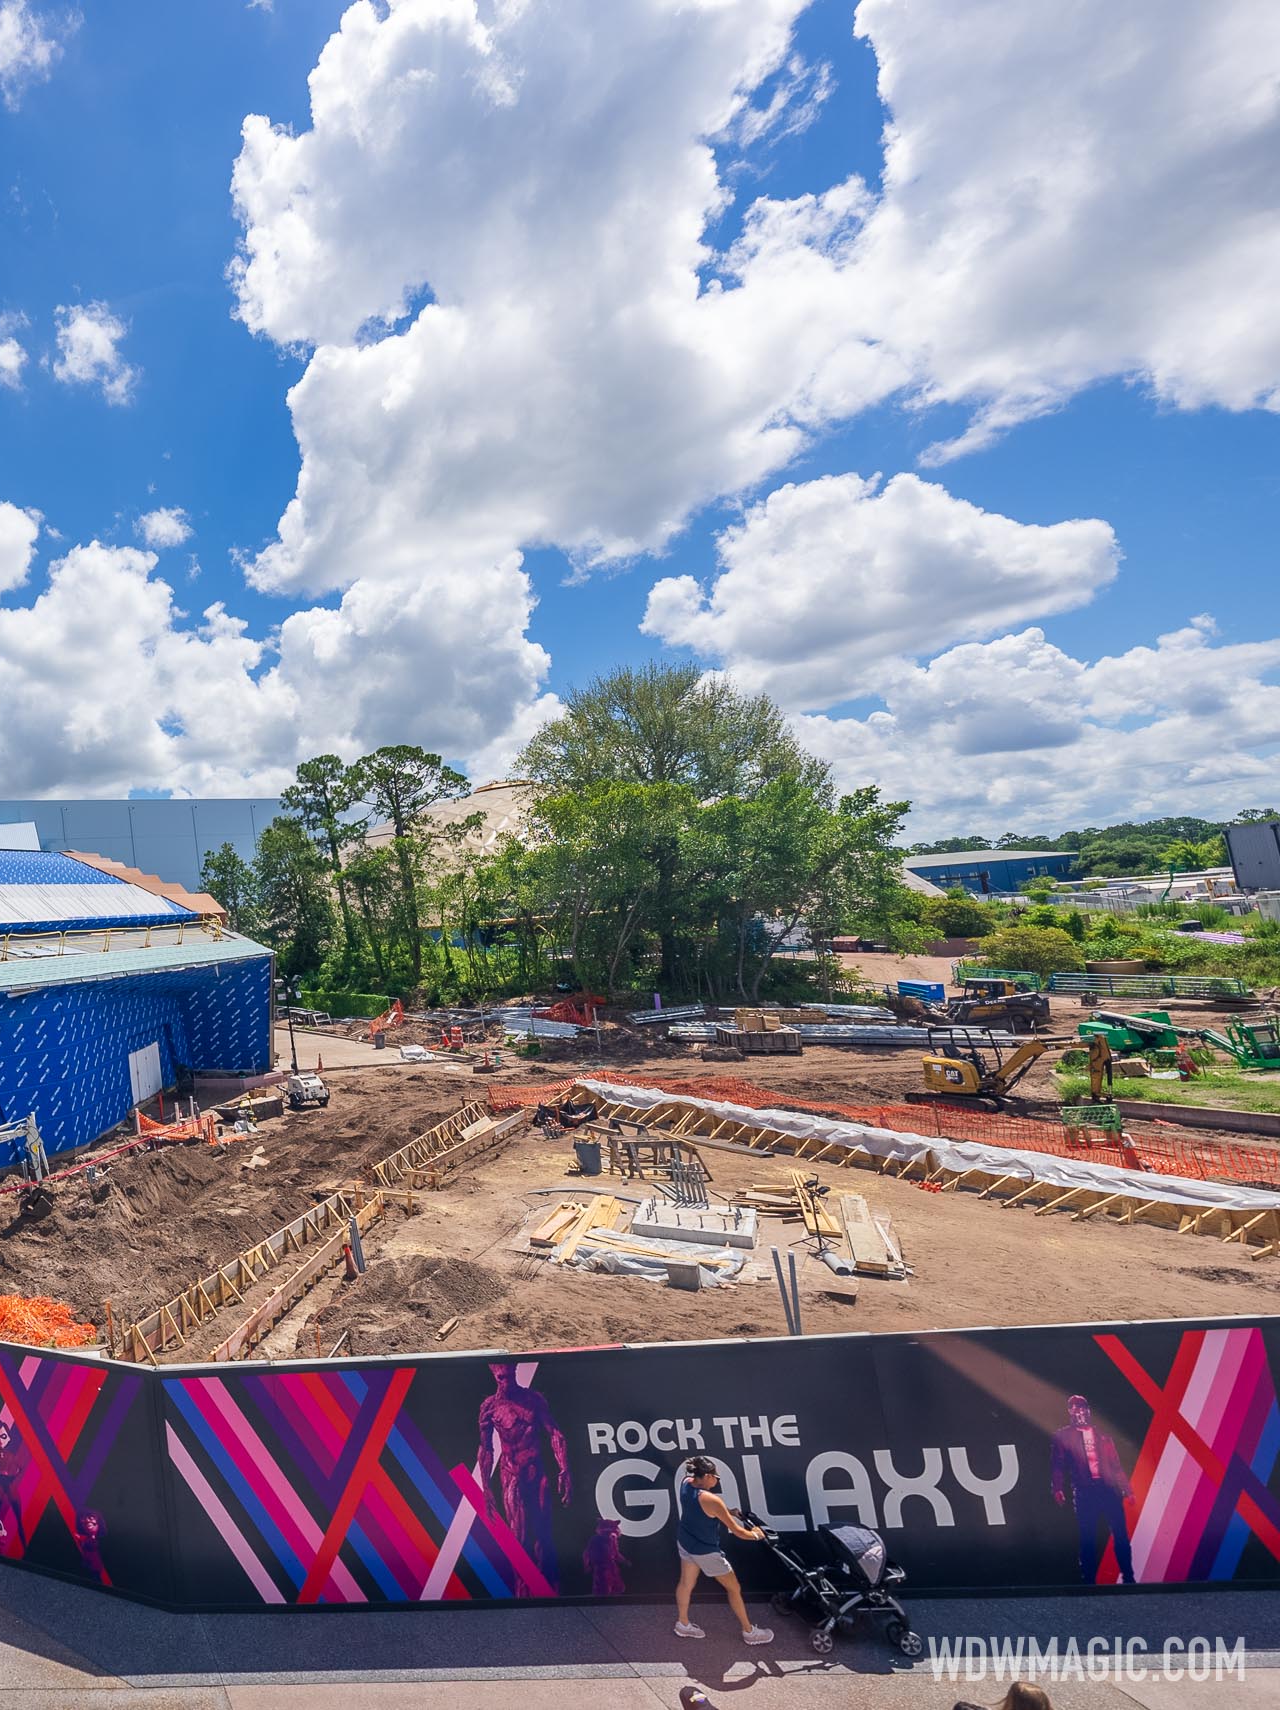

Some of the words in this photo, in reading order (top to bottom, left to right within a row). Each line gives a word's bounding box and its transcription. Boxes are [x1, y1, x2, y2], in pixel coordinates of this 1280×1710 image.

[587, 1418, 706, 1454] ROCK
[712, 1414, 801, 1449] THE
[595, 1444, 1020, 1538] GALAXY
